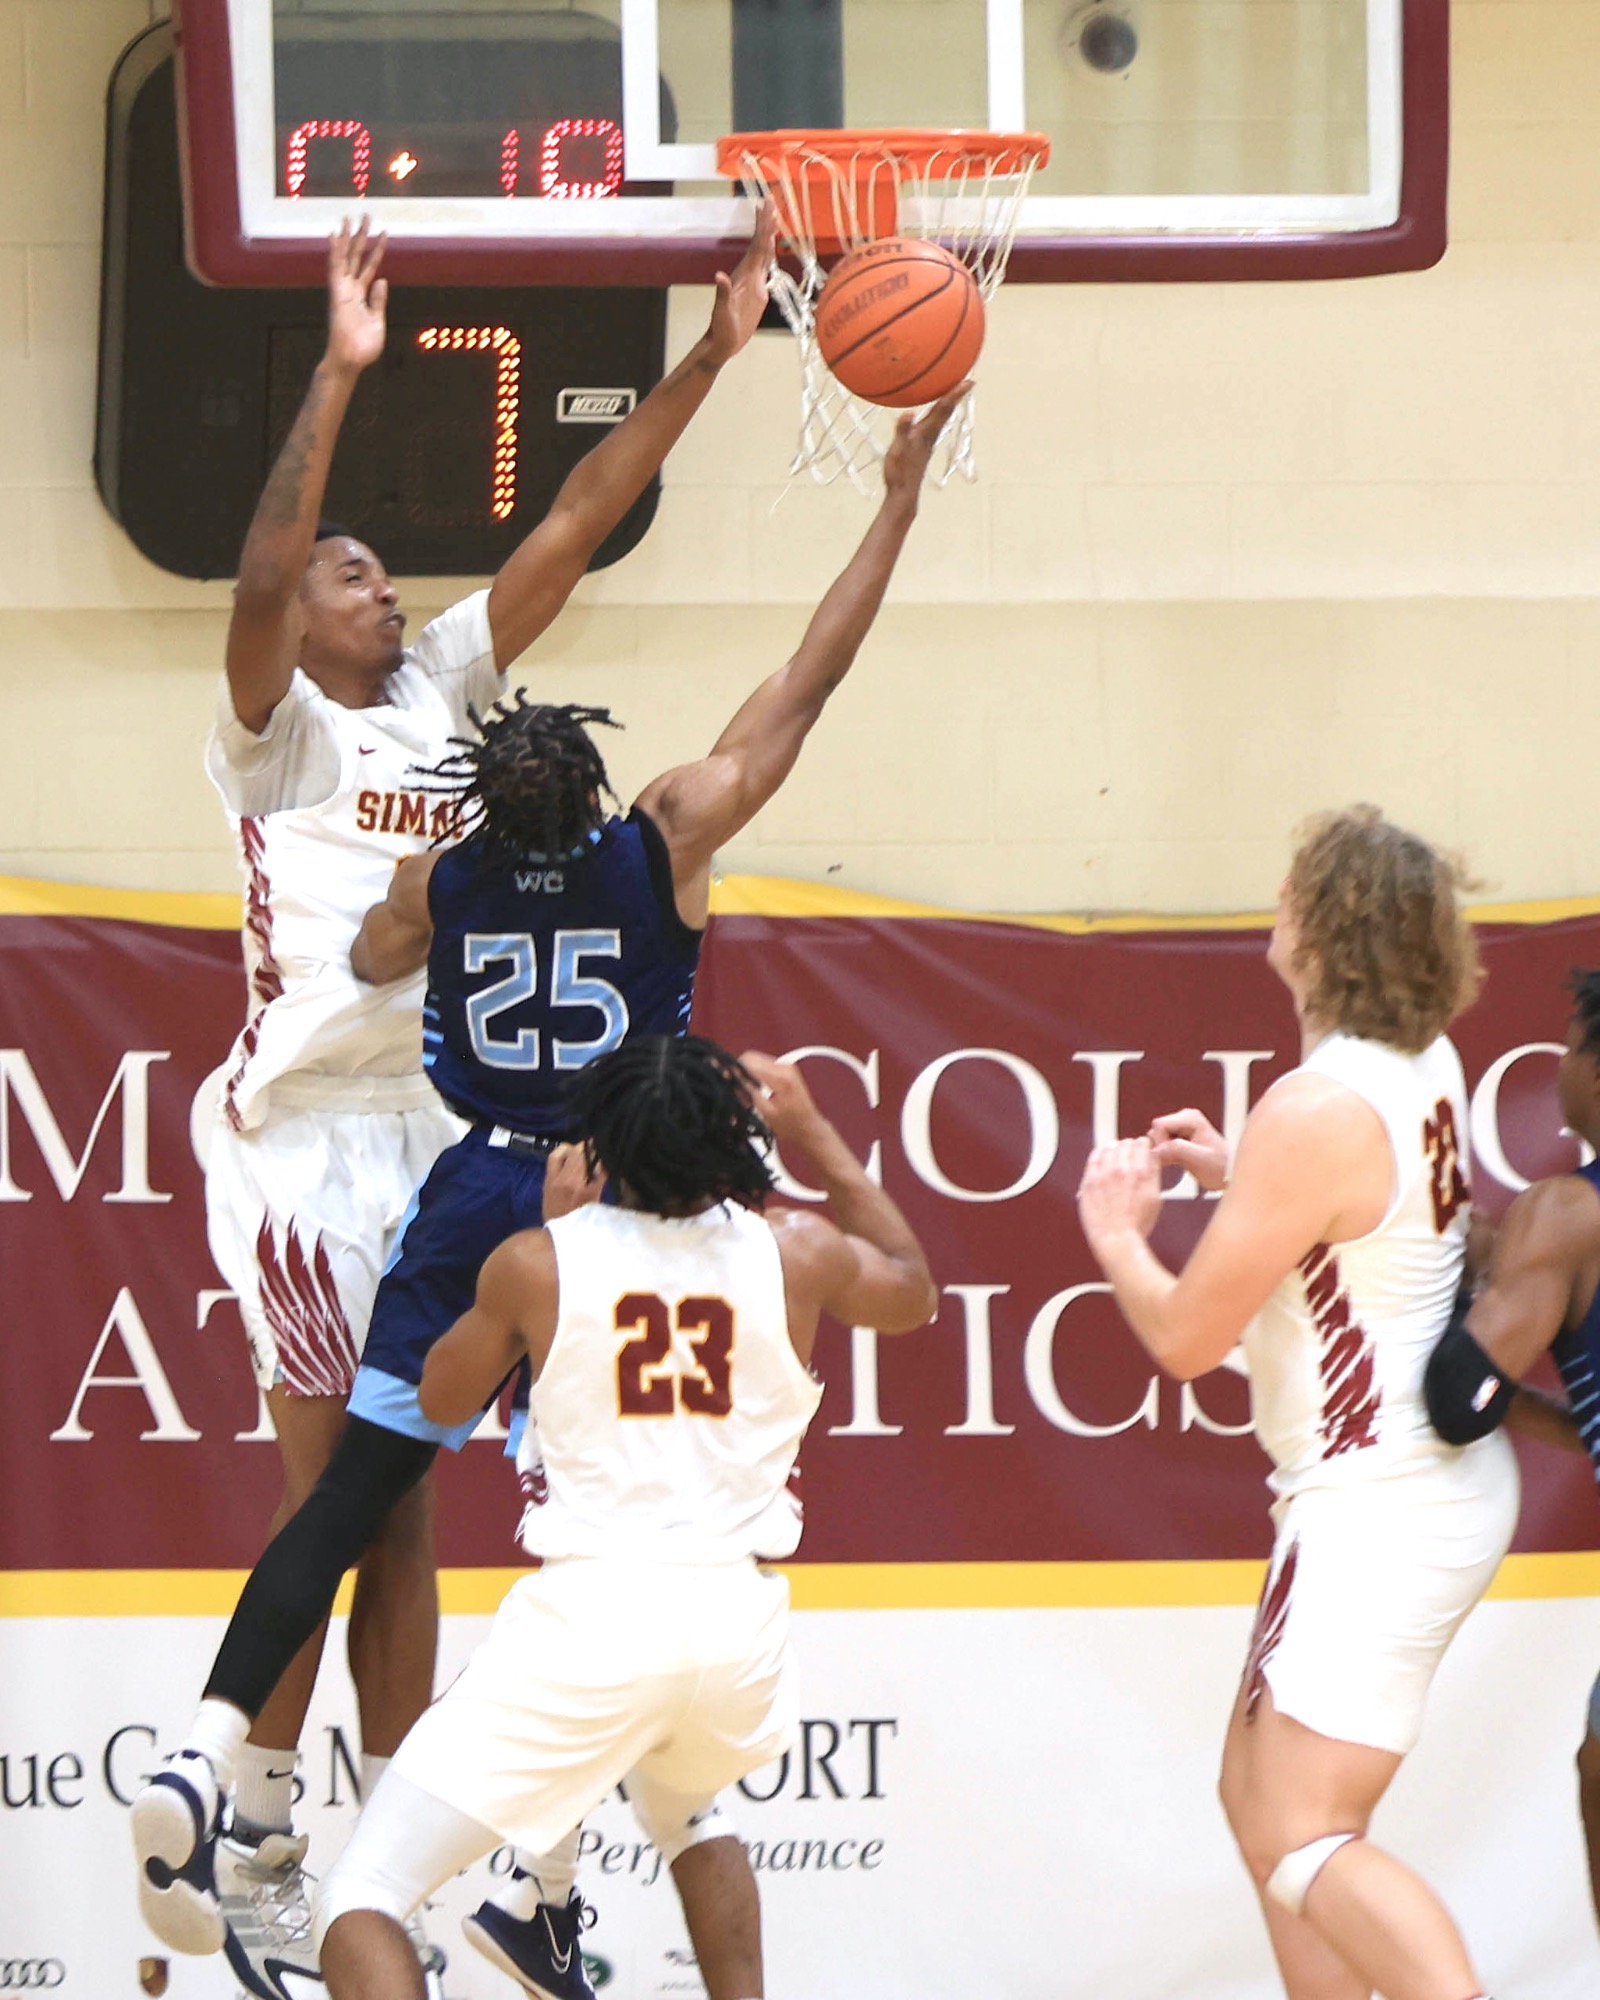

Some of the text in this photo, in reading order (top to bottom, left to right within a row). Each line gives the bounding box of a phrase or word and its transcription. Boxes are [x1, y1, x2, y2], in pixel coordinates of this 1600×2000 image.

[418, 326, 521, 519] 7
[464, 928, 630, 1071] 25
[613, 1290, 735, 1420] 23
